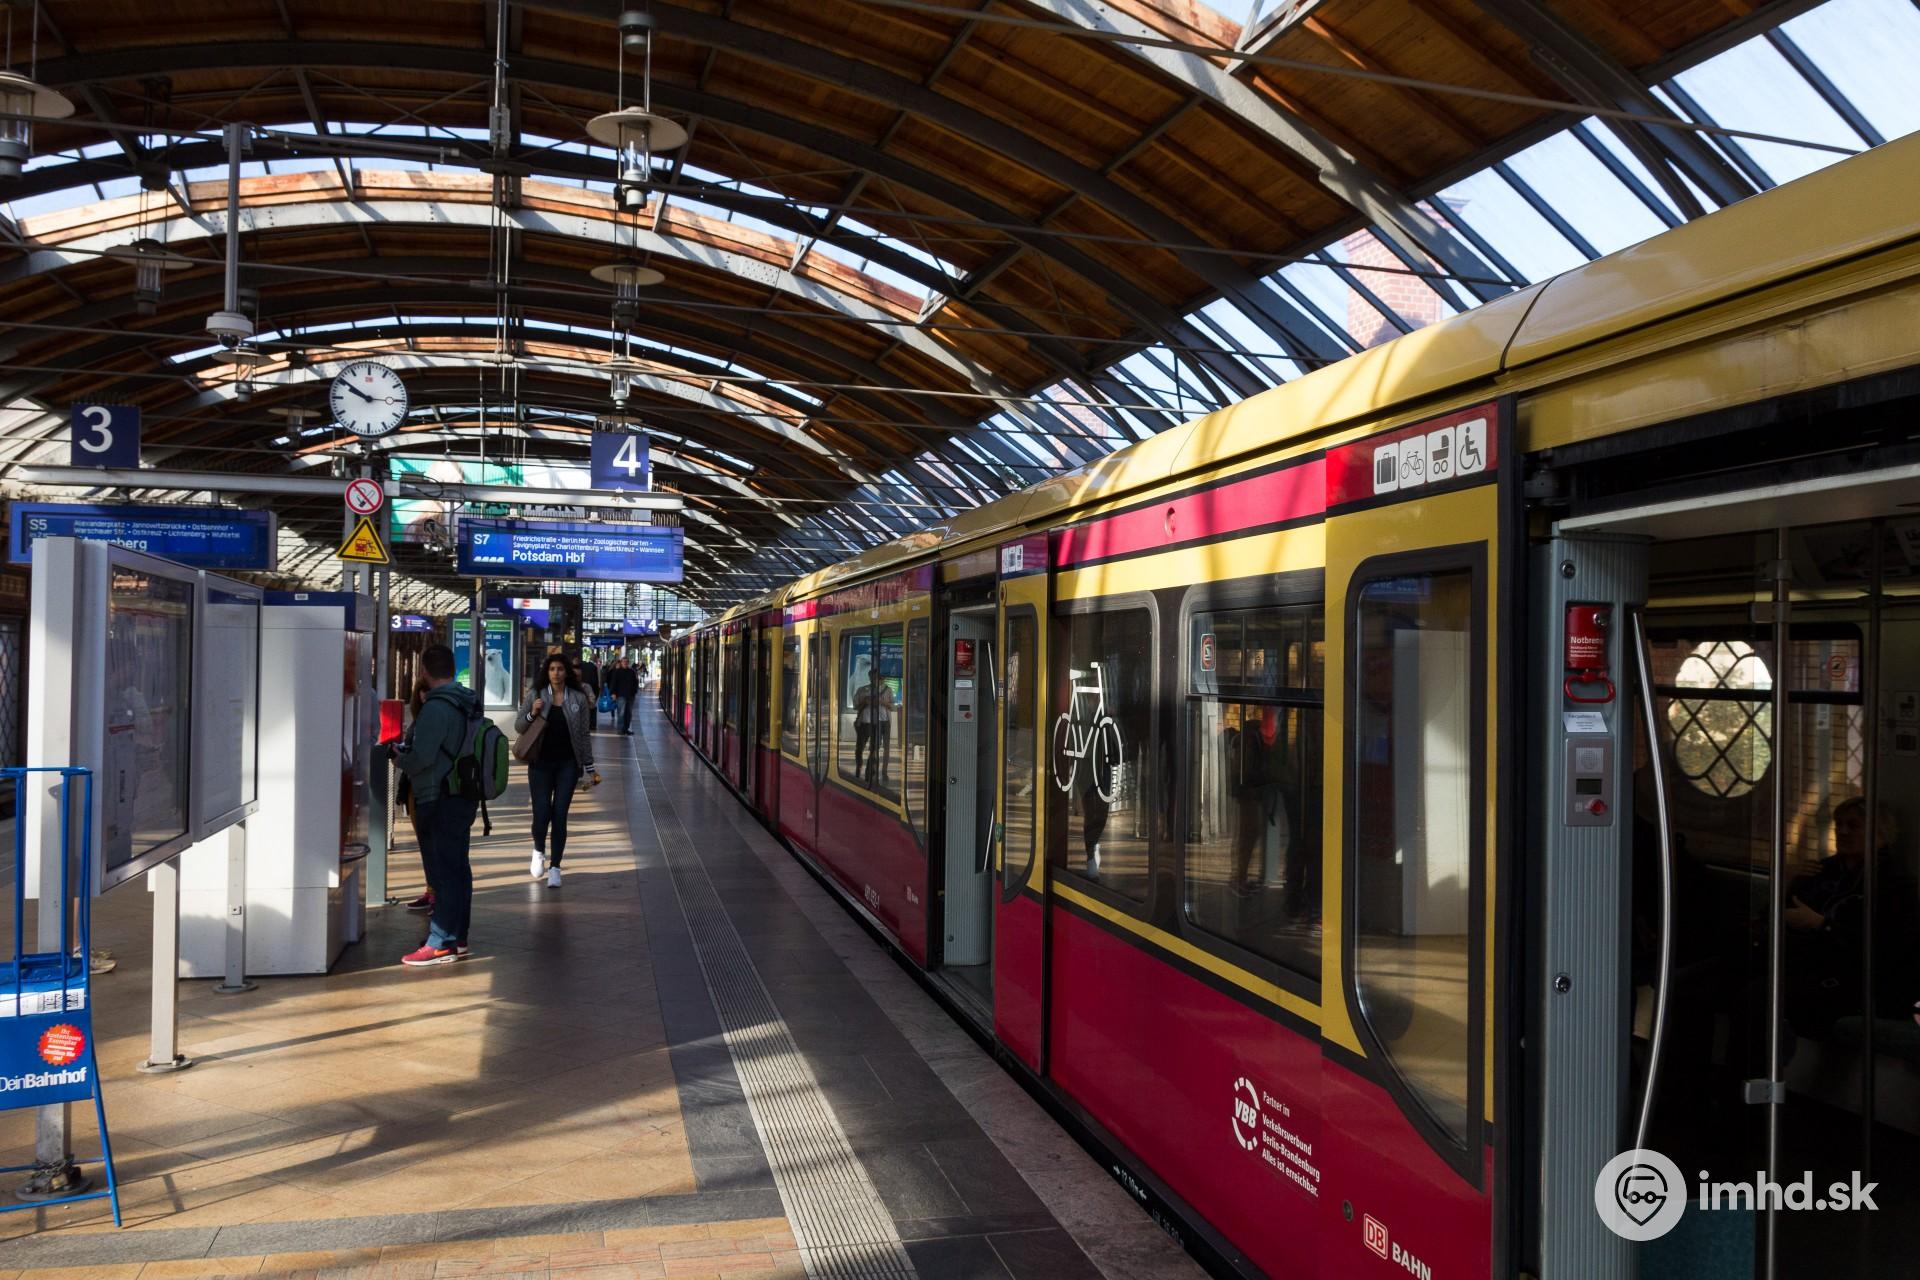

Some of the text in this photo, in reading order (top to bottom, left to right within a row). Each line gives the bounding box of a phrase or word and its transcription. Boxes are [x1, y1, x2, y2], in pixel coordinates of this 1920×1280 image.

[79, 406, 113, 453] 3
[612, 435, 641, 477] 4
[29, 518, 48, 531] S5
[74, 527, 113, 535] Warschauer
[168, 530, 206, 539] Lichtenberg
[473, 534, 490, 545] S7
[513, 535, 557, 543] Friedrichstraße
[593, 538, 629, 546] Zoologischer
[513, 541, 551, 550] Savignyplatz
[555, 543, 600, 552] Charlottenburg
[603, 545, 635, 553] Westkreuz
[512, 549, 586, 563] Potsdam Hbf
[391, 614, 402, 628] 3
[648, 620, 657, 632] 4
[1235, 1097, 1257, 1129] VBB
[1262, 1091, 1290, 1118] Partner im
[1262, 1113, 1312, 1156] Verkehrsverbund
[1262, 1130, 1320, 1183] Berlin-Brandenburg
[1262, 1148, 1319, 1198] Alles ist erreichbar.
[1367, 1220, 1432, 1280] DB BAHN
